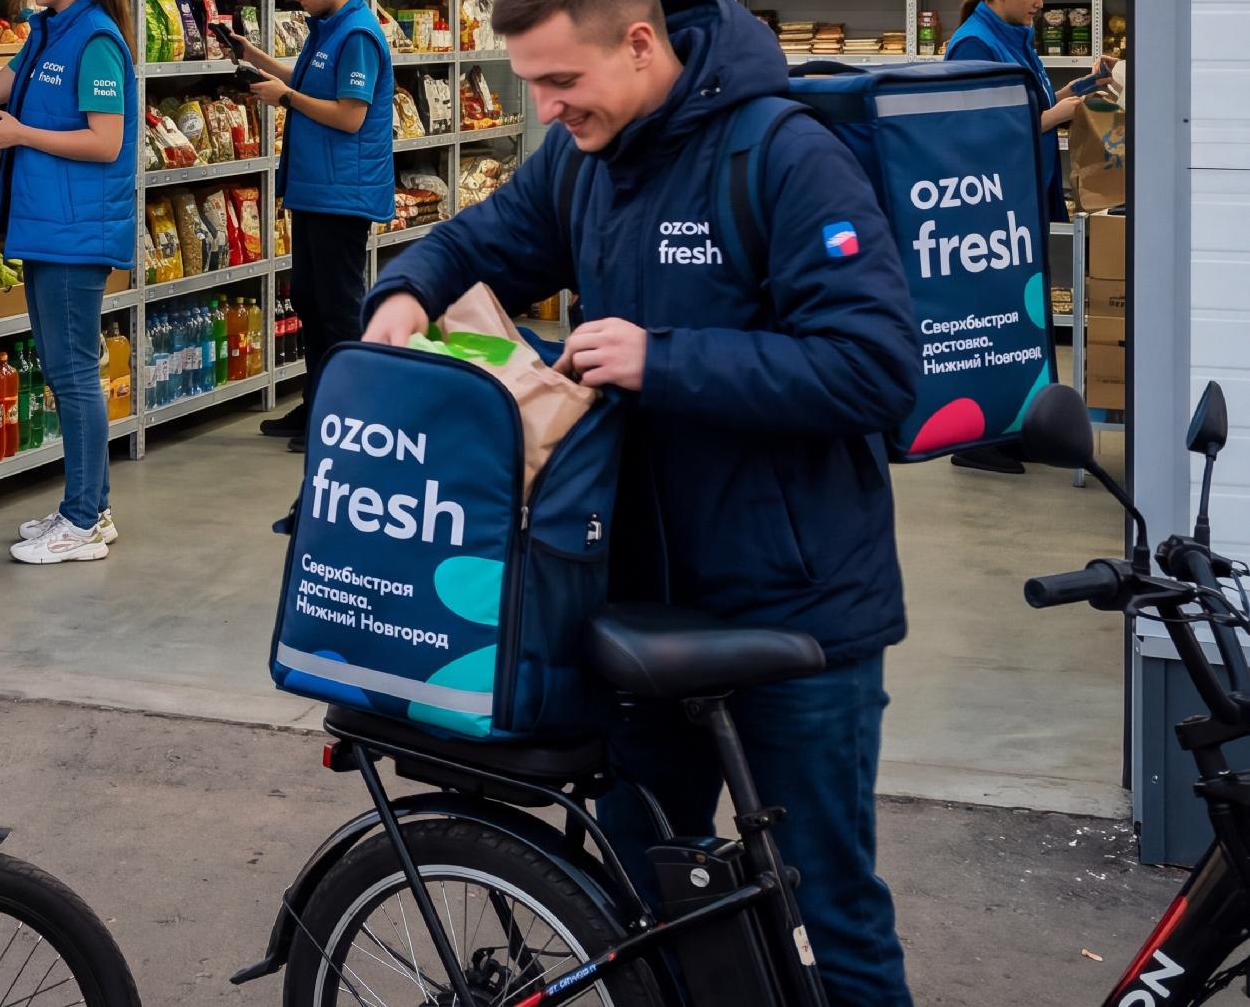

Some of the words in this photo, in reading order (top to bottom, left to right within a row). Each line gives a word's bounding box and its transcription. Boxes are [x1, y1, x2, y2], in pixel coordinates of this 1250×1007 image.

[910, 173, 1004, 210] OZON
[659, 221, 710, 236] OZON
[912, 210, 1033, 279] fresh
[658, 239, 723, 265] fresh
[923, 353, 981, 375] Нижний
[320, 413, 427, 465] OZON
[312, 457, 465, 546] fresh
[298, 579, 372, 611] доставка.
[301, 553, 414, 597] Сверхбыстрая
[296, 594, 356, 627] Нижний
[361, 613, 449, 650] Новгород
